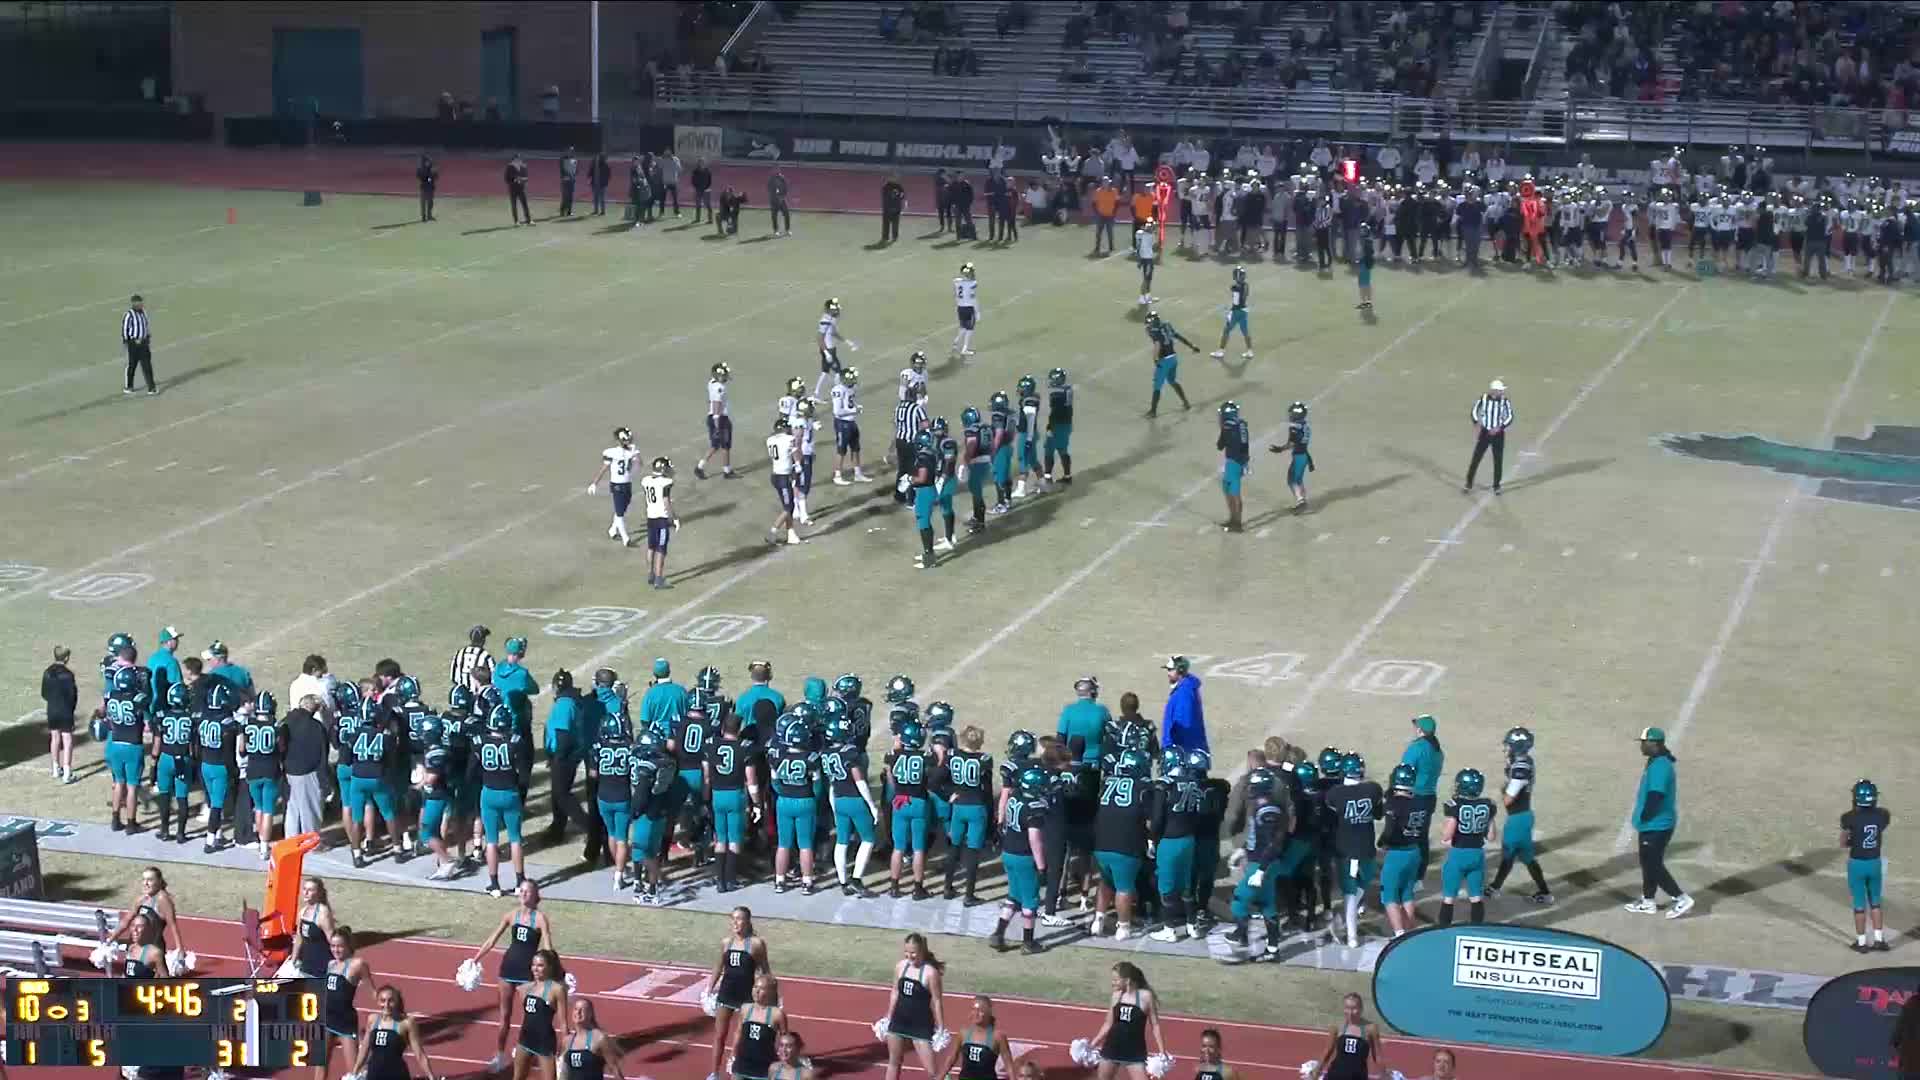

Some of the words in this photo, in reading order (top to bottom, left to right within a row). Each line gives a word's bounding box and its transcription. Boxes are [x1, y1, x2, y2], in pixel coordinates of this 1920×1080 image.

[646, 485, 657, 503] 18
[106, 698, 137, 726] 96
[162, 716, 192, 745] 36
[245, 725, 276, 753] 30
[684, 723, 702, 753] 0
[352, 732, 384, 761] 44
[481, 743, 512, 771] 81
[716, 745, 734, 775] 3
[599, 747, 629, 776] 23
[775, 758, 808, 786] 42
[892, 754, 925, 785] 48
[1100, 777, 1135, 808] 79
[1458, 804, 1490, 834] 92
[1862, 824, 1880, 850] 2
[1462, 945, 1595, 973] TIGHTSEAL
[1469, 969, 1585, 991] INSULATION
